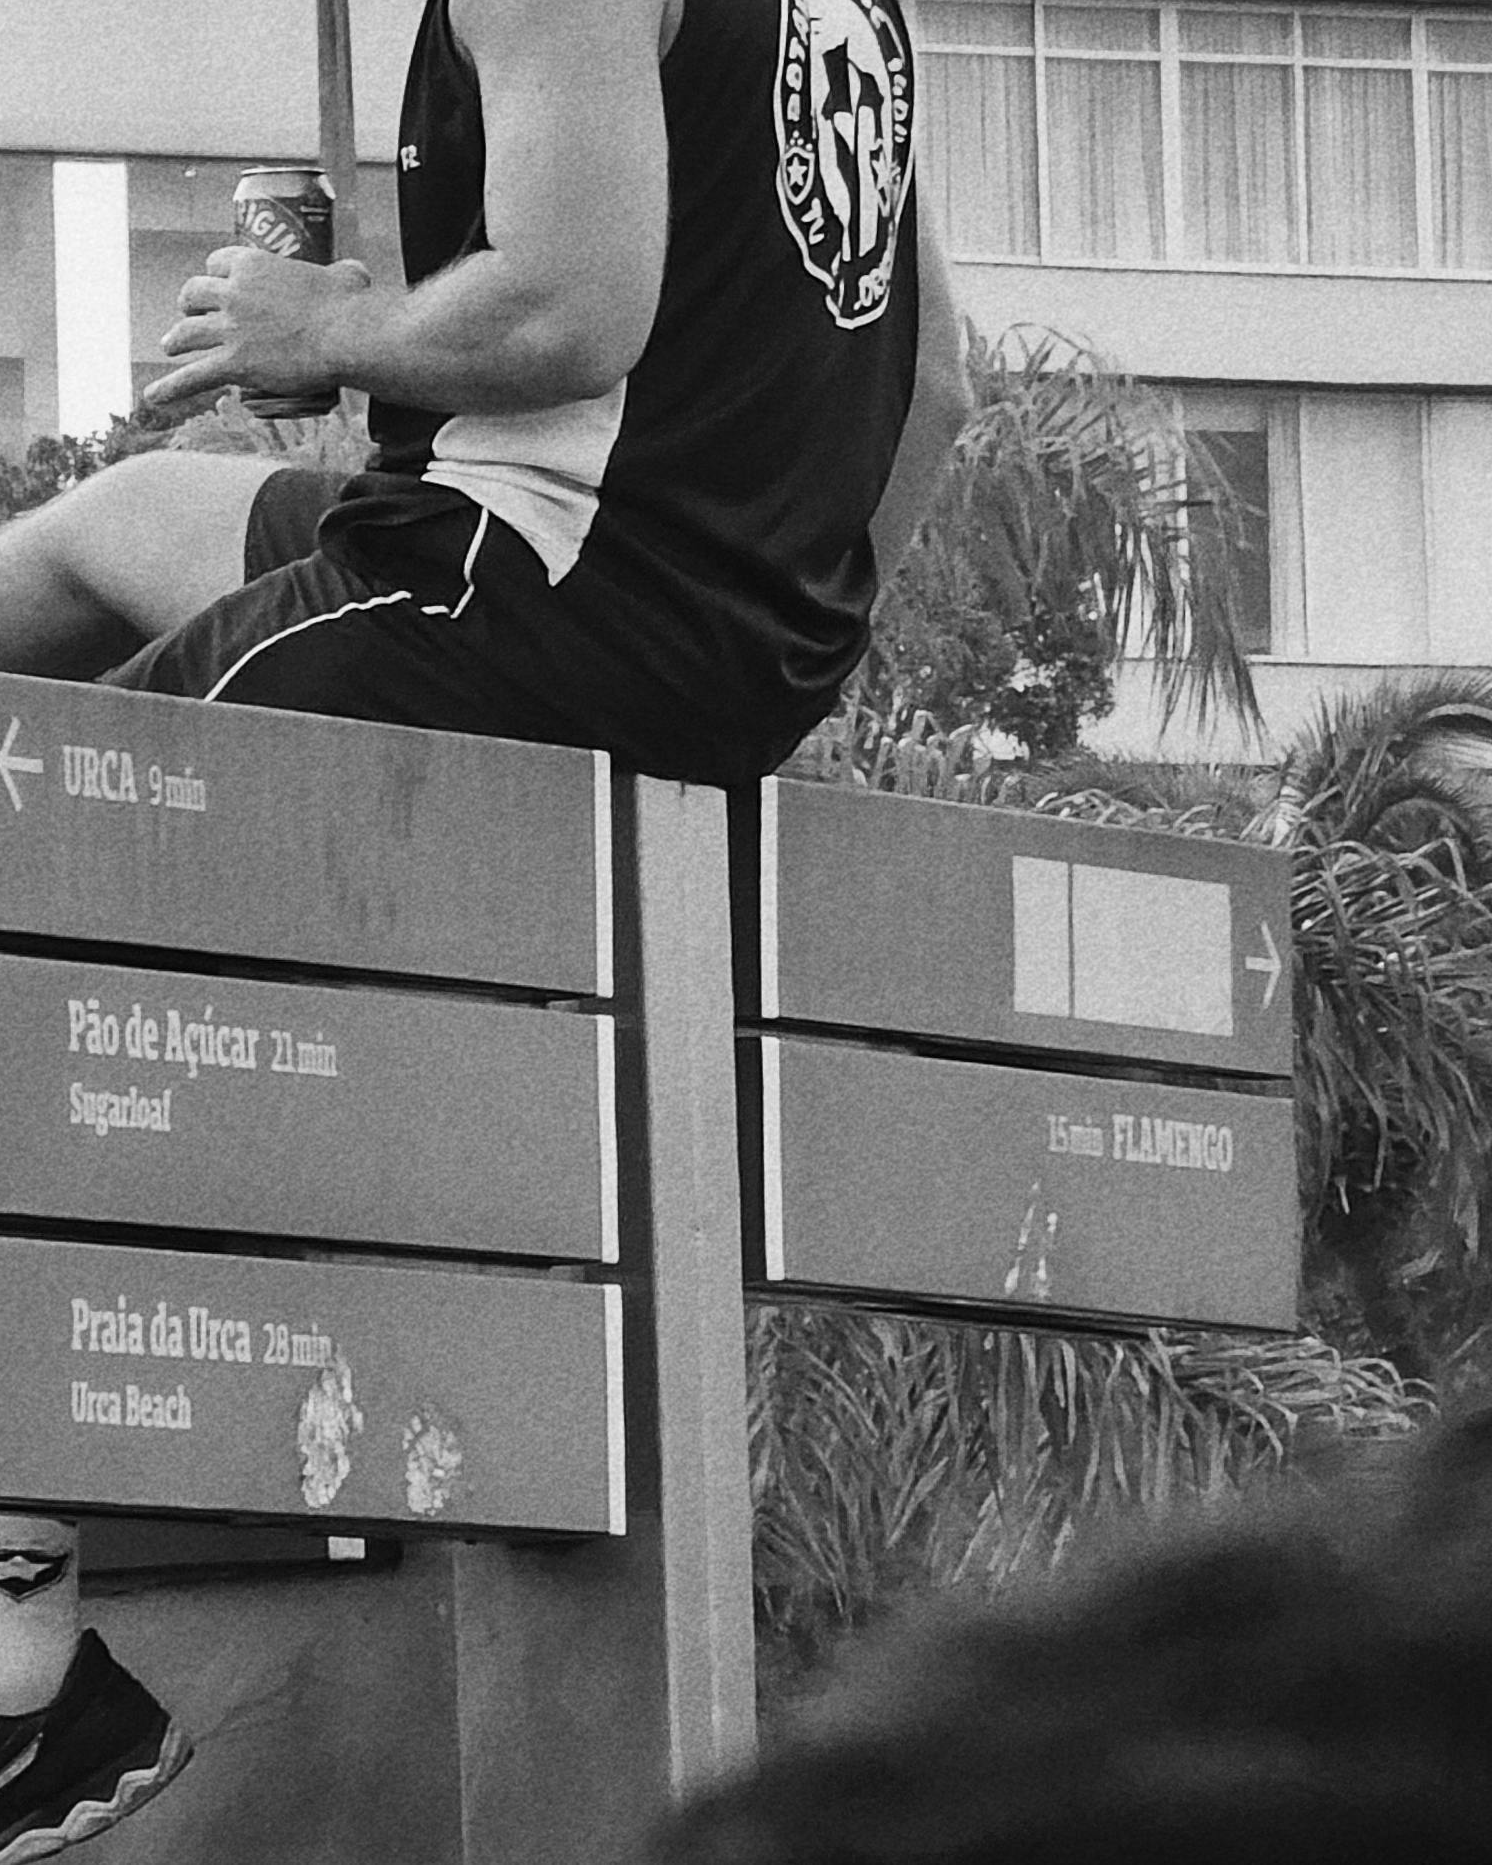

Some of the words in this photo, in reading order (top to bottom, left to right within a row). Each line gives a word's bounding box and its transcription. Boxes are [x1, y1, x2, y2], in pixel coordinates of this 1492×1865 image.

[62, 745, 139, 803] URCA
[67, 997, 120, 1056] Pão
[124, 1003, 159, 1061] de
[164, 1004, 260, 1079] Açúcar
[69, 1081, 172, 1137] Sugarloaf
[1112, 1113, 1233, 1173] FLAMENGO
[71, 1294, 146, 1356] Praia
[149, 1301, 185, 1358] da
[188, 1306, 252, 1363] Urca
[71, 1381, 122, 1425] Urca
[125, 1384, 192, 1430] Beach
